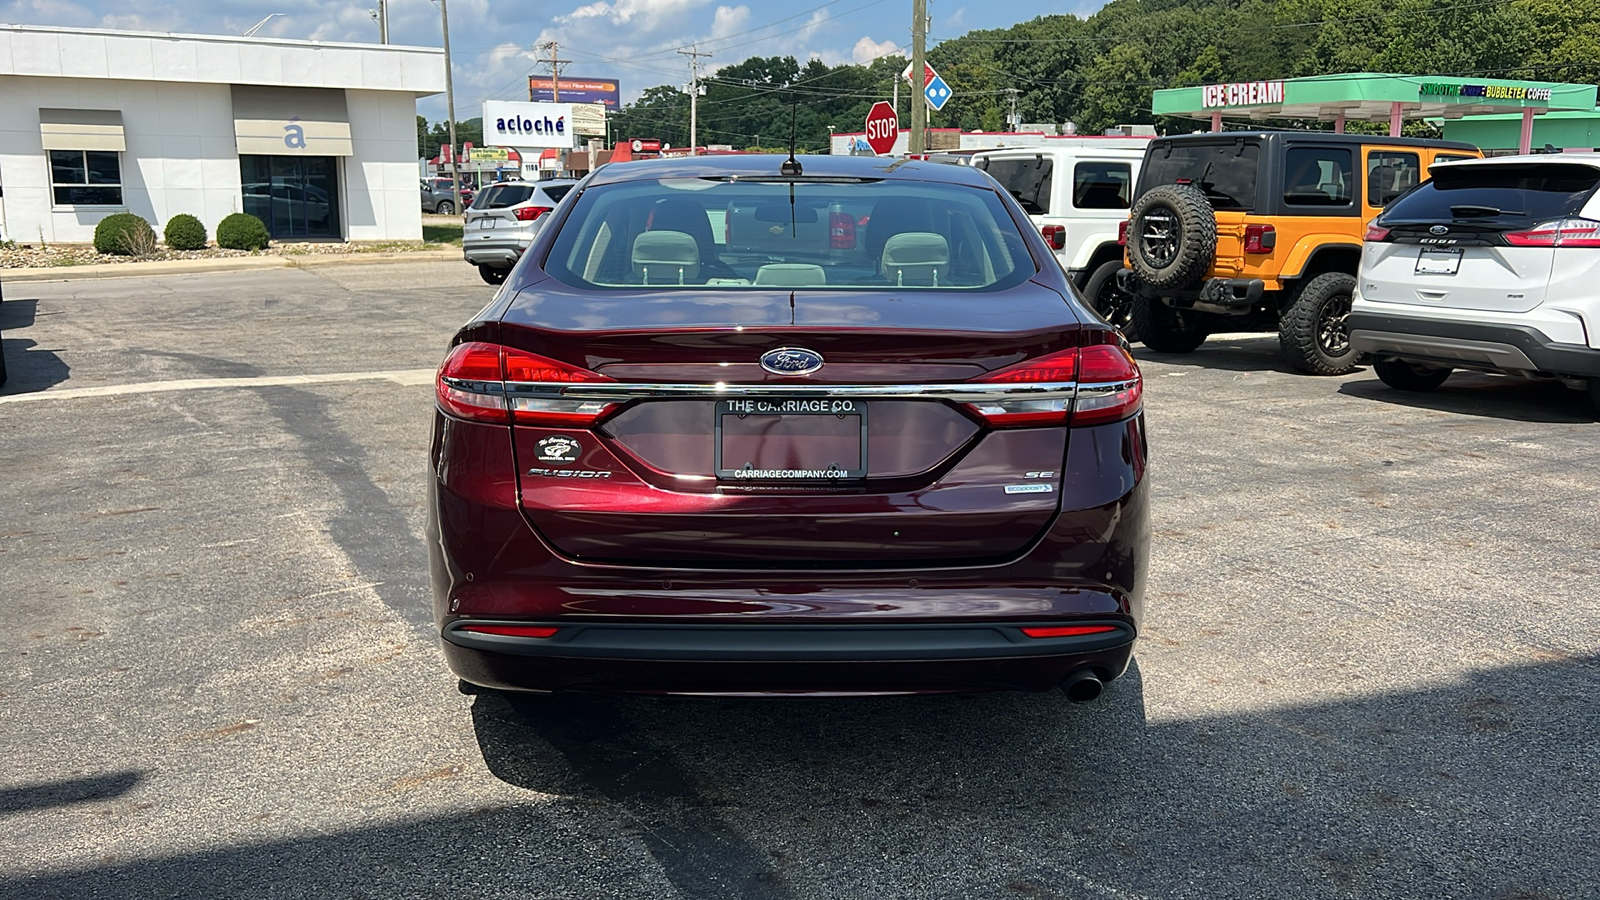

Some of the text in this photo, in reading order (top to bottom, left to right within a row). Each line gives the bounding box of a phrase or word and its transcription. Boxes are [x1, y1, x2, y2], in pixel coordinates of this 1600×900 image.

[1202, 81, 1284, 108] ICE CREAM
[1421, 83, 1461, 96] SMOOTHIE
[1526, 88, 1552, 100] COFFEE
[496, 114, 564, 132] acloché
[868, 118, 896, 140] STOP
[773, 351, 810, 370] Ford
[727, 400, 754, 412] THE
[757, 400, 829, 412] CARRIAGE
[527, 468, 612, 479] FUSION
[734, 469, 848, 479] CARRIAGECOMPANY.COM
[1024, 471, 1055, 479] SE
